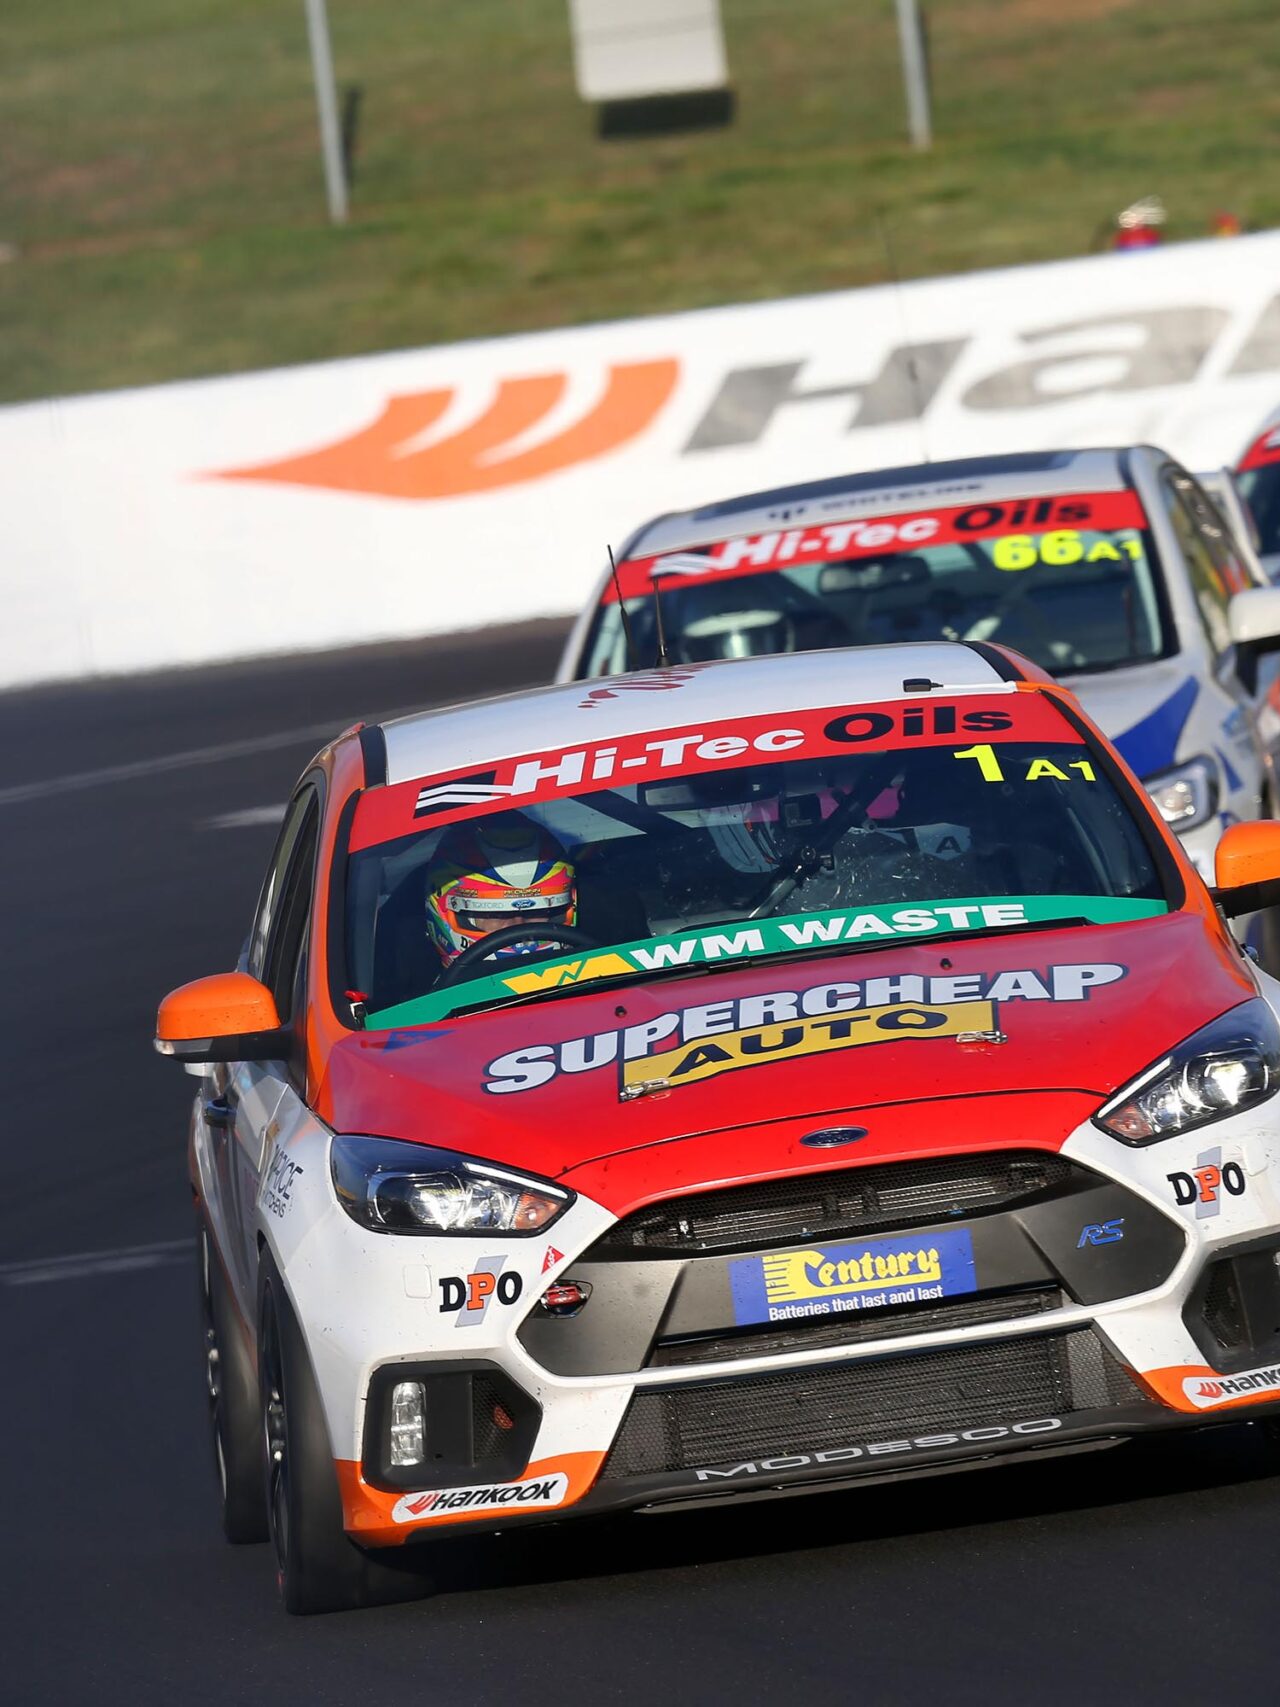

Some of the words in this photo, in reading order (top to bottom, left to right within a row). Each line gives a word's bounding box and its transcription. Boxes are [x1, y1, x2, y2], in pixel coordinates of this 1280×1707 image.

[713, 517, 940, 571] Hi-Tec
[953, 500, 1092, 532] Oils
[992, 529, 1083, 571] 66
[511, 728, 805, 797] Hi-Tec
[823, 706, 1013, 743] Oils
[953, 744, 1005, 782] 1
[1025, 758, 1097, 782] A1
[778, 904, 1031, 944] WASTE
[481, 963, 1128, 1095] SUPERCHEAP
[669, 1008, 948, 1080] AUTO
[1166, 1161, 1246, 1206] DPO
[1076, 1218, 1125, 1249] RS
[438, 1270, 523, 1313] DPO
[763, 1249, 942, 1303] Century
[769, 1301, 830, 1322] Batteries
[833, 1297, 860, 1314] that
[862, 1293, 887, 1311] last
[890, 1289, 916, 1305] and
[918, 1284, 944, 1301] last
[695, 1418, 1063, 1481] MODESCO
